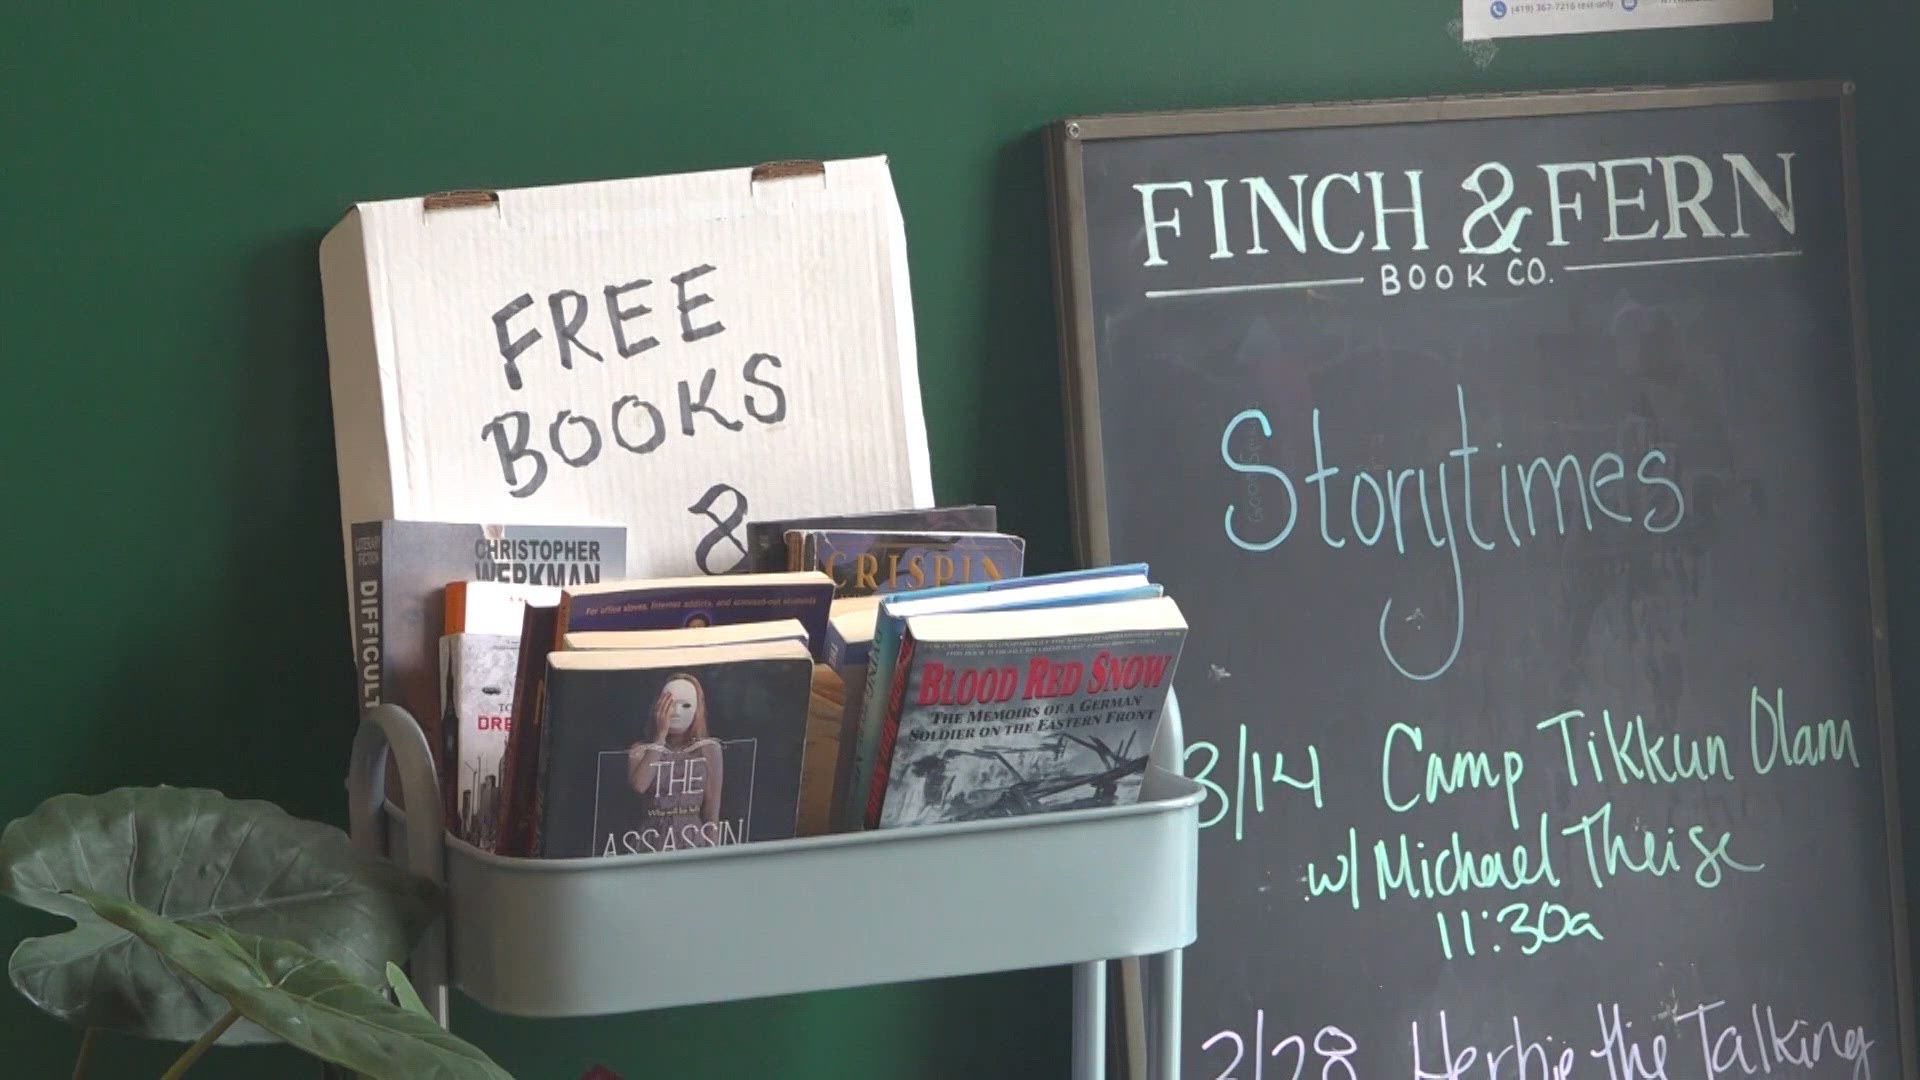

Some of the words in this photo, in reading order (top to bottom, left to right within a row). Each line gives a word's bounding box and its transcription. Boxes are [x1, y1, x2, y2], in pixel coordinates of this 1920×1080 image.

[1132, 169, 1429, 268] FINCH
[1460, 161, 1532, 255] &
[1536, 152, 1796, 247] FERN
[1381, 262, 1488, 297] BOOK
[1506, 257, 1556, 288] CO.
[491, 263, 726, 390] FREE
[481, 353, 786, 498] BOOKS
[474, 539, 601, 562] CHRISTOPHER
[687, 483, 748, 575] &
[1221, 384, 1685, 680] Storytimes
[824, 549, 1017, 591] CRISPIN
[916, 660, 1020, 707] BLOOD
[1022, 655, 1084, 701] RED
[1086, 650, 1173, 695] SNOW
[478, 715, 512, 732] DRE
[908, 727, 976, 744] SOLDIER
[978, 725, 999, 739] ON
[1002, 721, 1034, 736] THE
[1036, 714, 1104, 732] EASTERN
[1105, 708, 1157, 725] FRONT
[930, 710, 962, 726] THE
[966, 706, 1041, 724] MEMOIRS
[1043, 703, 1061, 717] OF
[1063, 702, 1075, 715] A
[1078, 695, 1143, 713] GERMAN
[649, 757, 707, 798] THE
[1183, 724, 1324, 842] 3/14
[1382, 722, 1524, 831] Camp
[1537, 709, 1734, 787] Tikkun
[1750, 686, 1860, 775] Olam
[602, 818, 744, 858] ASSASSIN
[1307, 827, 1360, 910] w/
[1374, 811, 1561, 901] Michael
[1437, 903, 1605, 960] 11:30a
[1589, 1003, 1667, 1080] the
[1673, 1000, 1876, 1080] Talking
